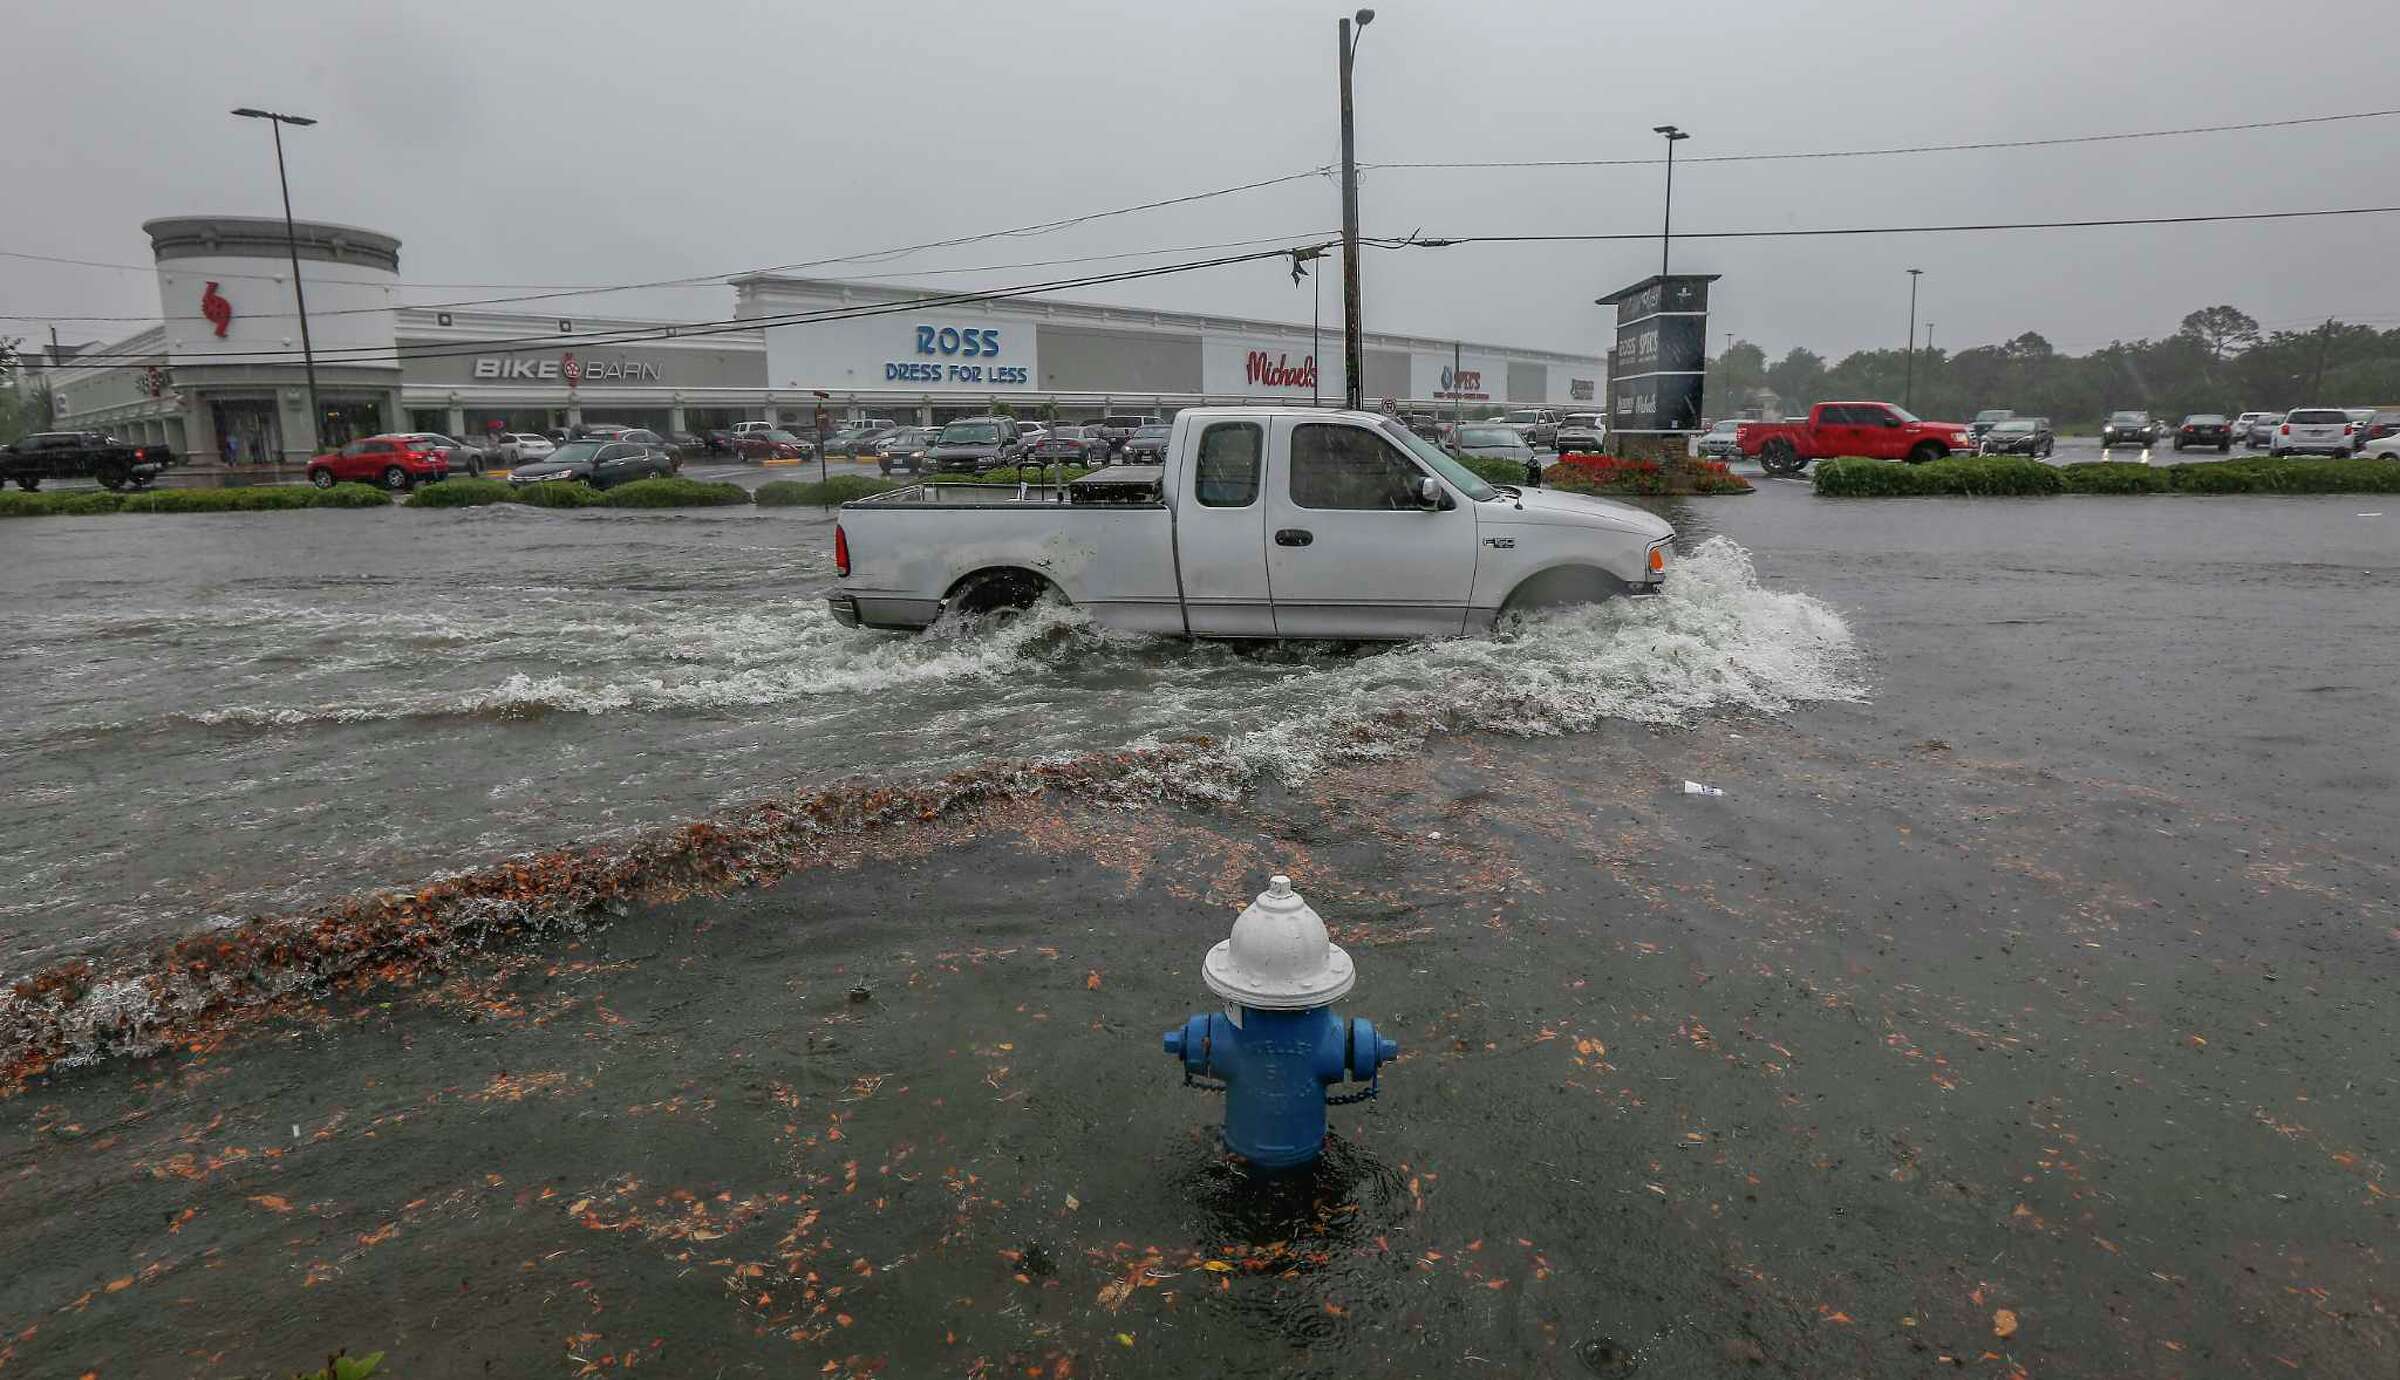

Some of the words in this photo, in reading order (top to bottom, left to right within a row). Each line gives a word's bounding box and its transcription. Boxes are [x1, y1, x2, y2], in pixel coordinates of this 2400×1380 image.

[916, 325, 999, 357] ROSS
[474, 358, 560, 378] BIKE
[585, 360, 663, 380] BARN
[885, 363, 942, 382] DRESS
[947, 365, 982, 383] FOR
[988, 366, 1028, 384] LESS
